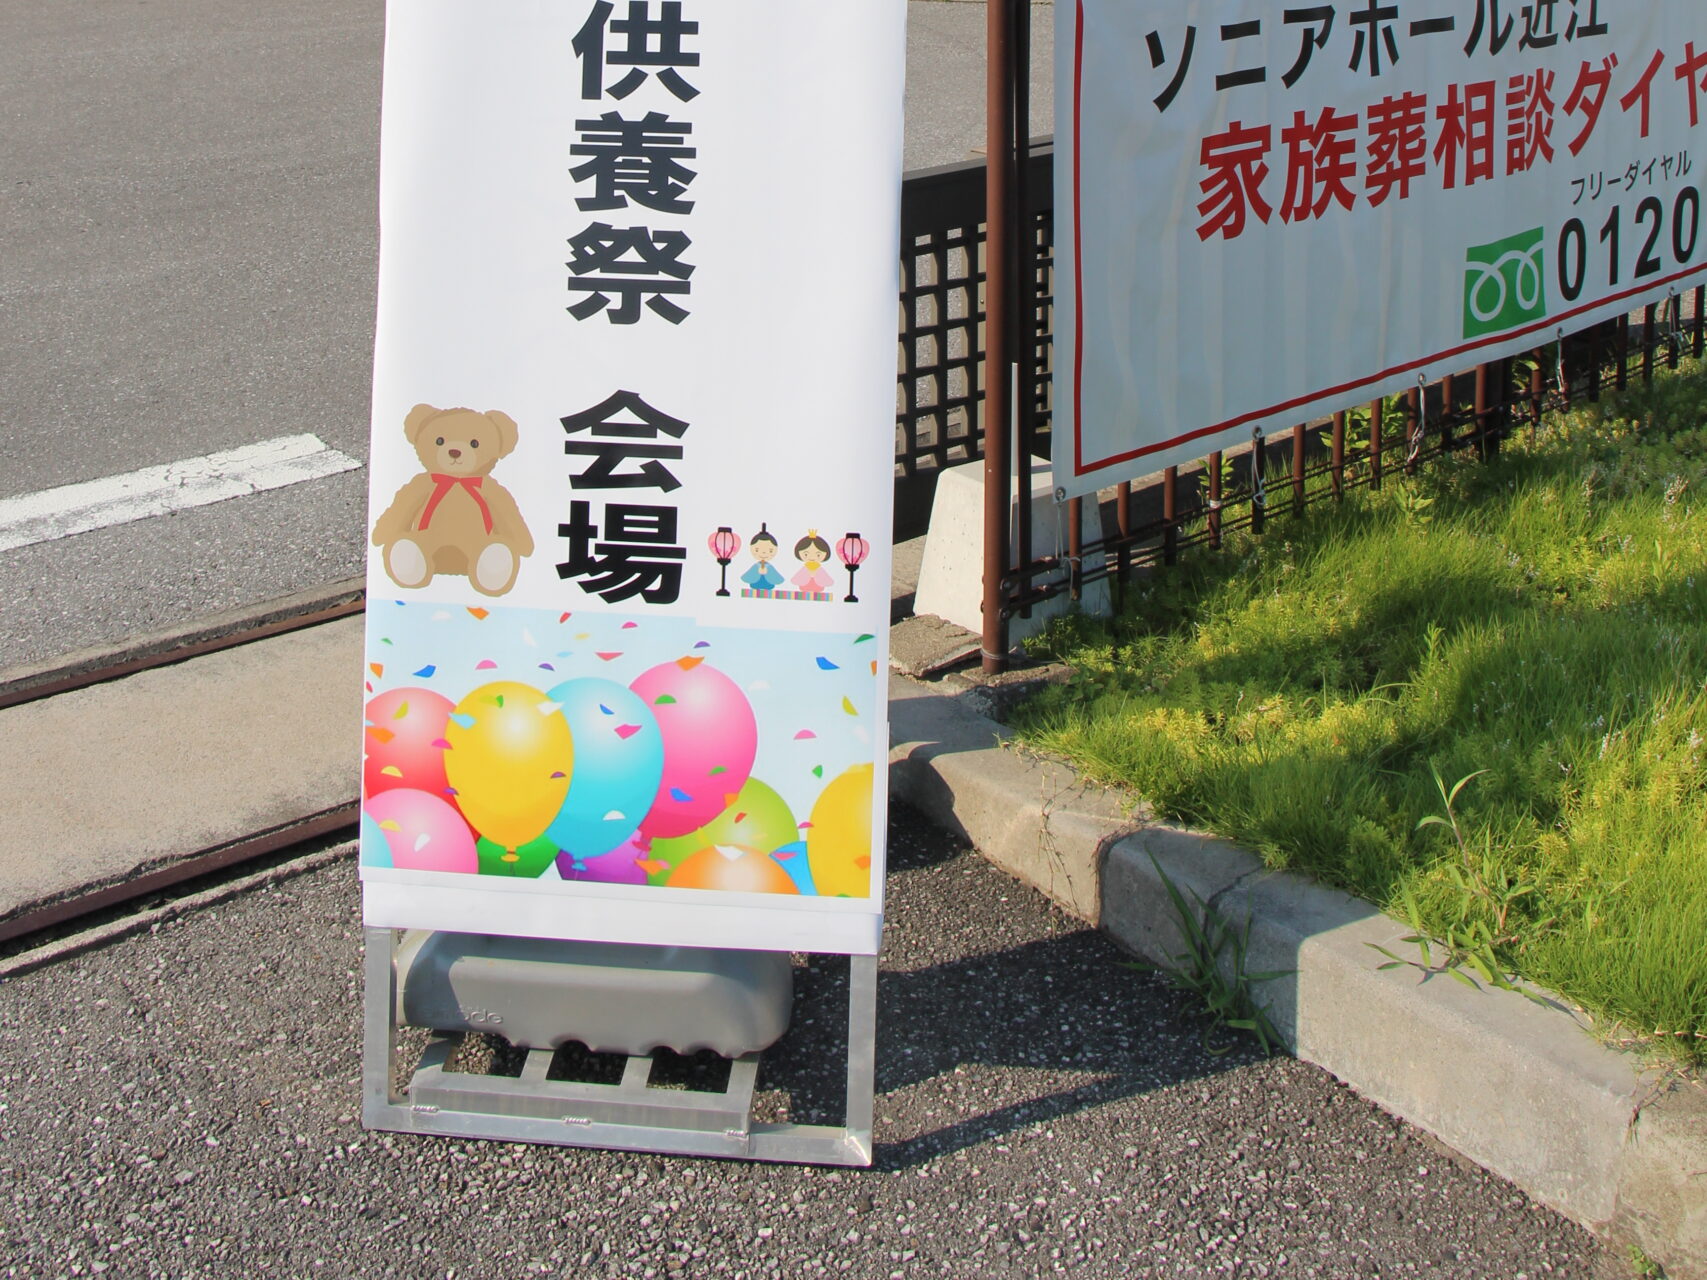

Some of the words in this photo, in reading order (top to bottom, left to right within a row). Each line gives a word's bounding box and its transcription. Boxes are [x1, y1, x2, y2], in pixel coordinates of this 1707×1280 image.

[1196, 40, 1707, 243] 家族葬相談ダイヤ
[1570, 150, 1692, 206] フリーダイヤル
[1558, 185, 1700, 302] 0120
[555, 389, 691, 605] 会場
